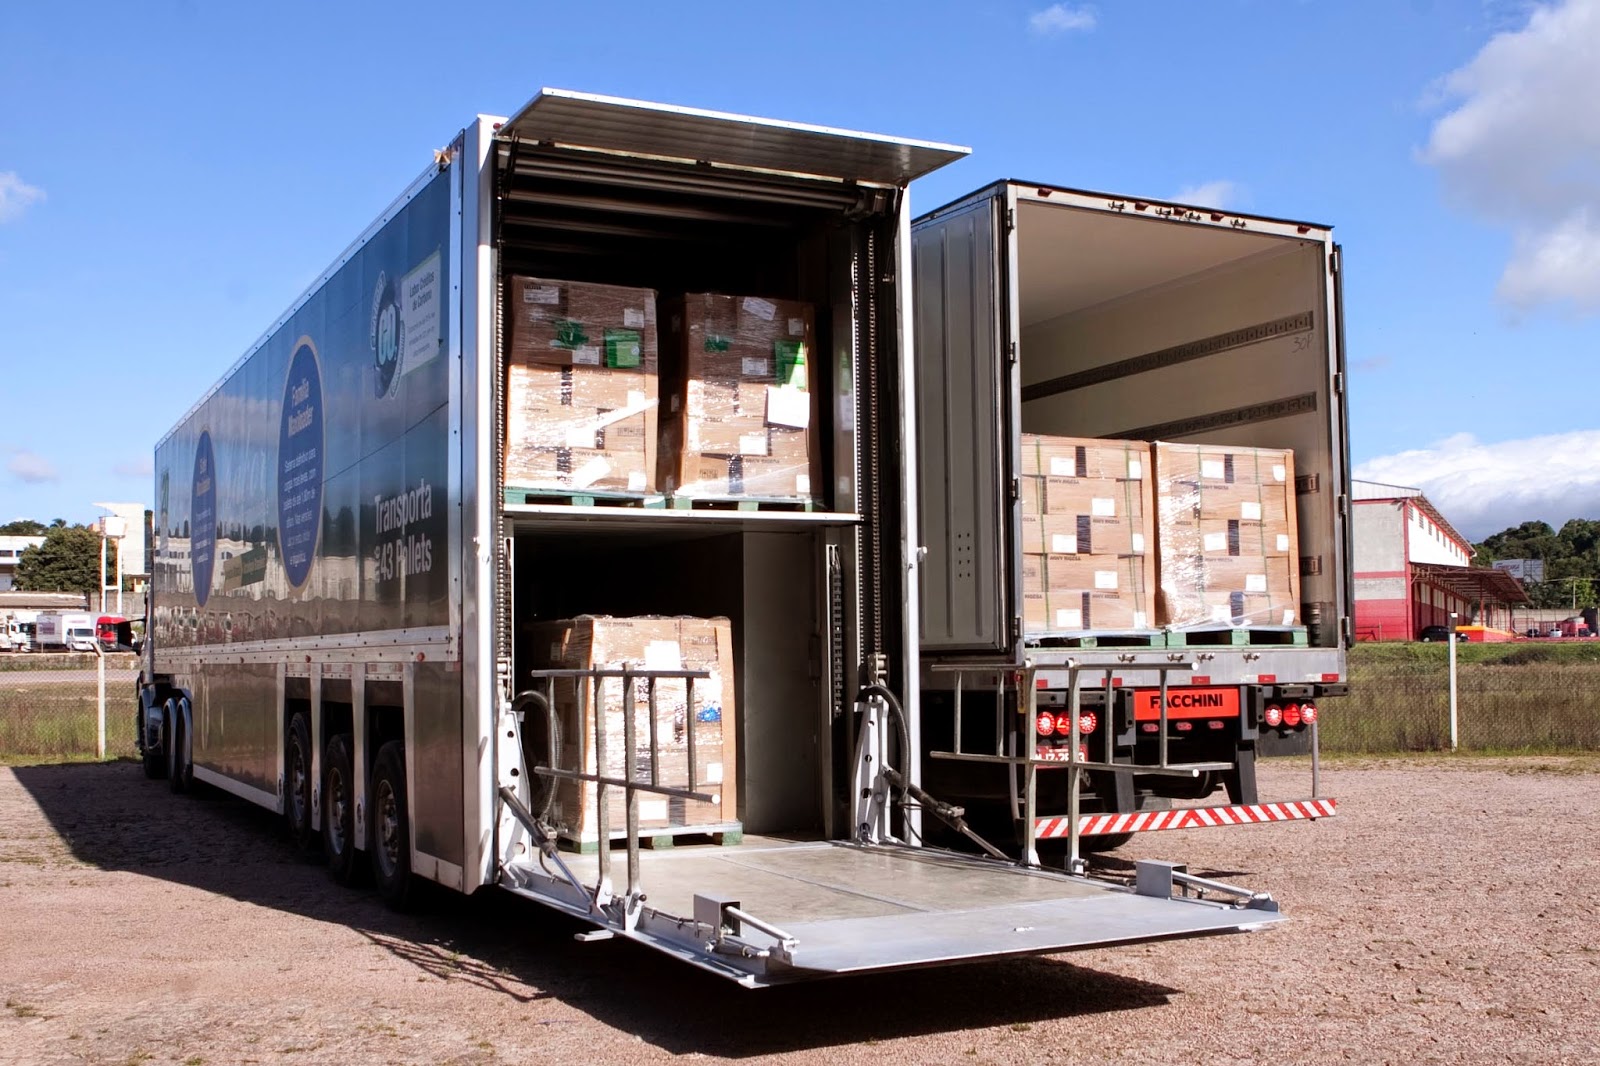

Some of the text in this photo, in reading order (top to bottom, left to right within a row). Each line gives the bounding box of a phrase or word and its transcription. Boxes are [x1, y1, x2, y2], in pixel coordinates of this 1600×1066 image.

[374, 478, 432, 535] Transporta
[380, 542, 394, 581] 43
[396, 533, 432, 578] Pallets
